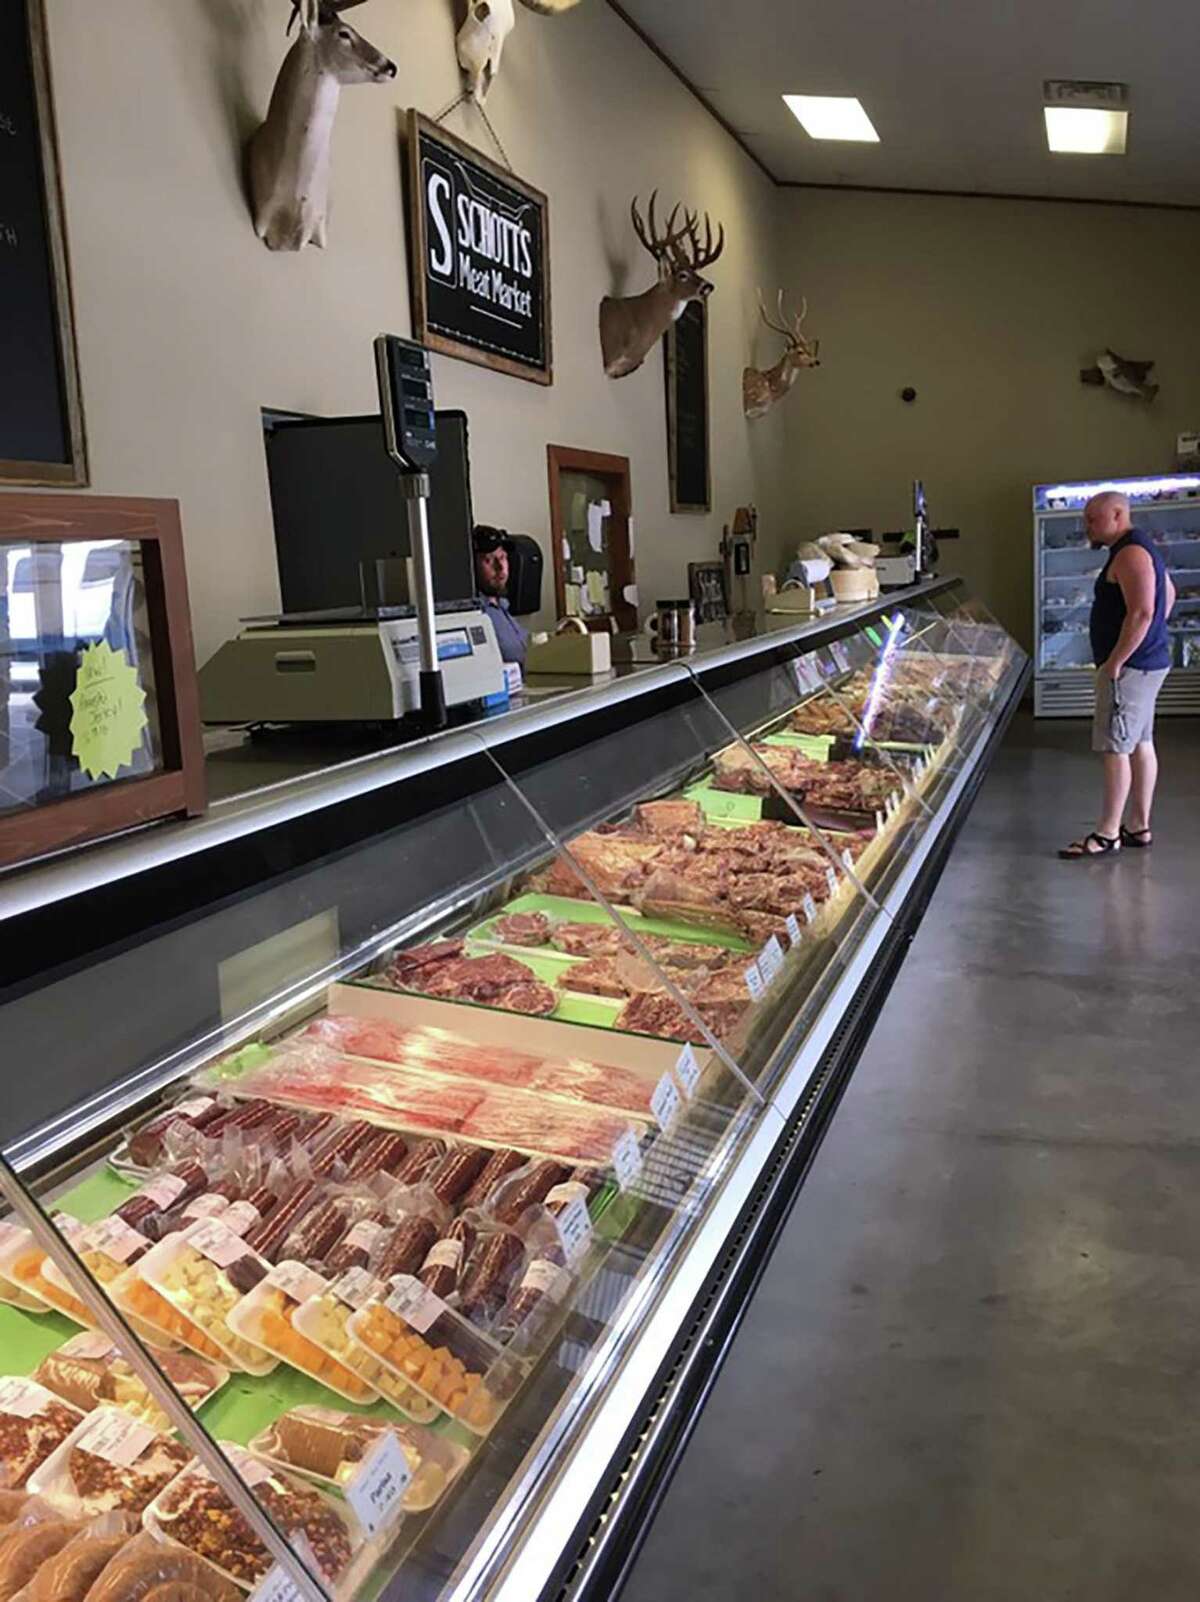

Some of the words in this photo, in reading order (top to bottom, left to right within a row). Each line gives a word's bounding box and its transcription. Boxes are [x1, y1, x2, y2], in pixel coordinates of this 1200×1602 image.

[427, 173, 452, 276] S
[458, 251, 490, 300] Meat
[491, 268, 532, 318] Market
